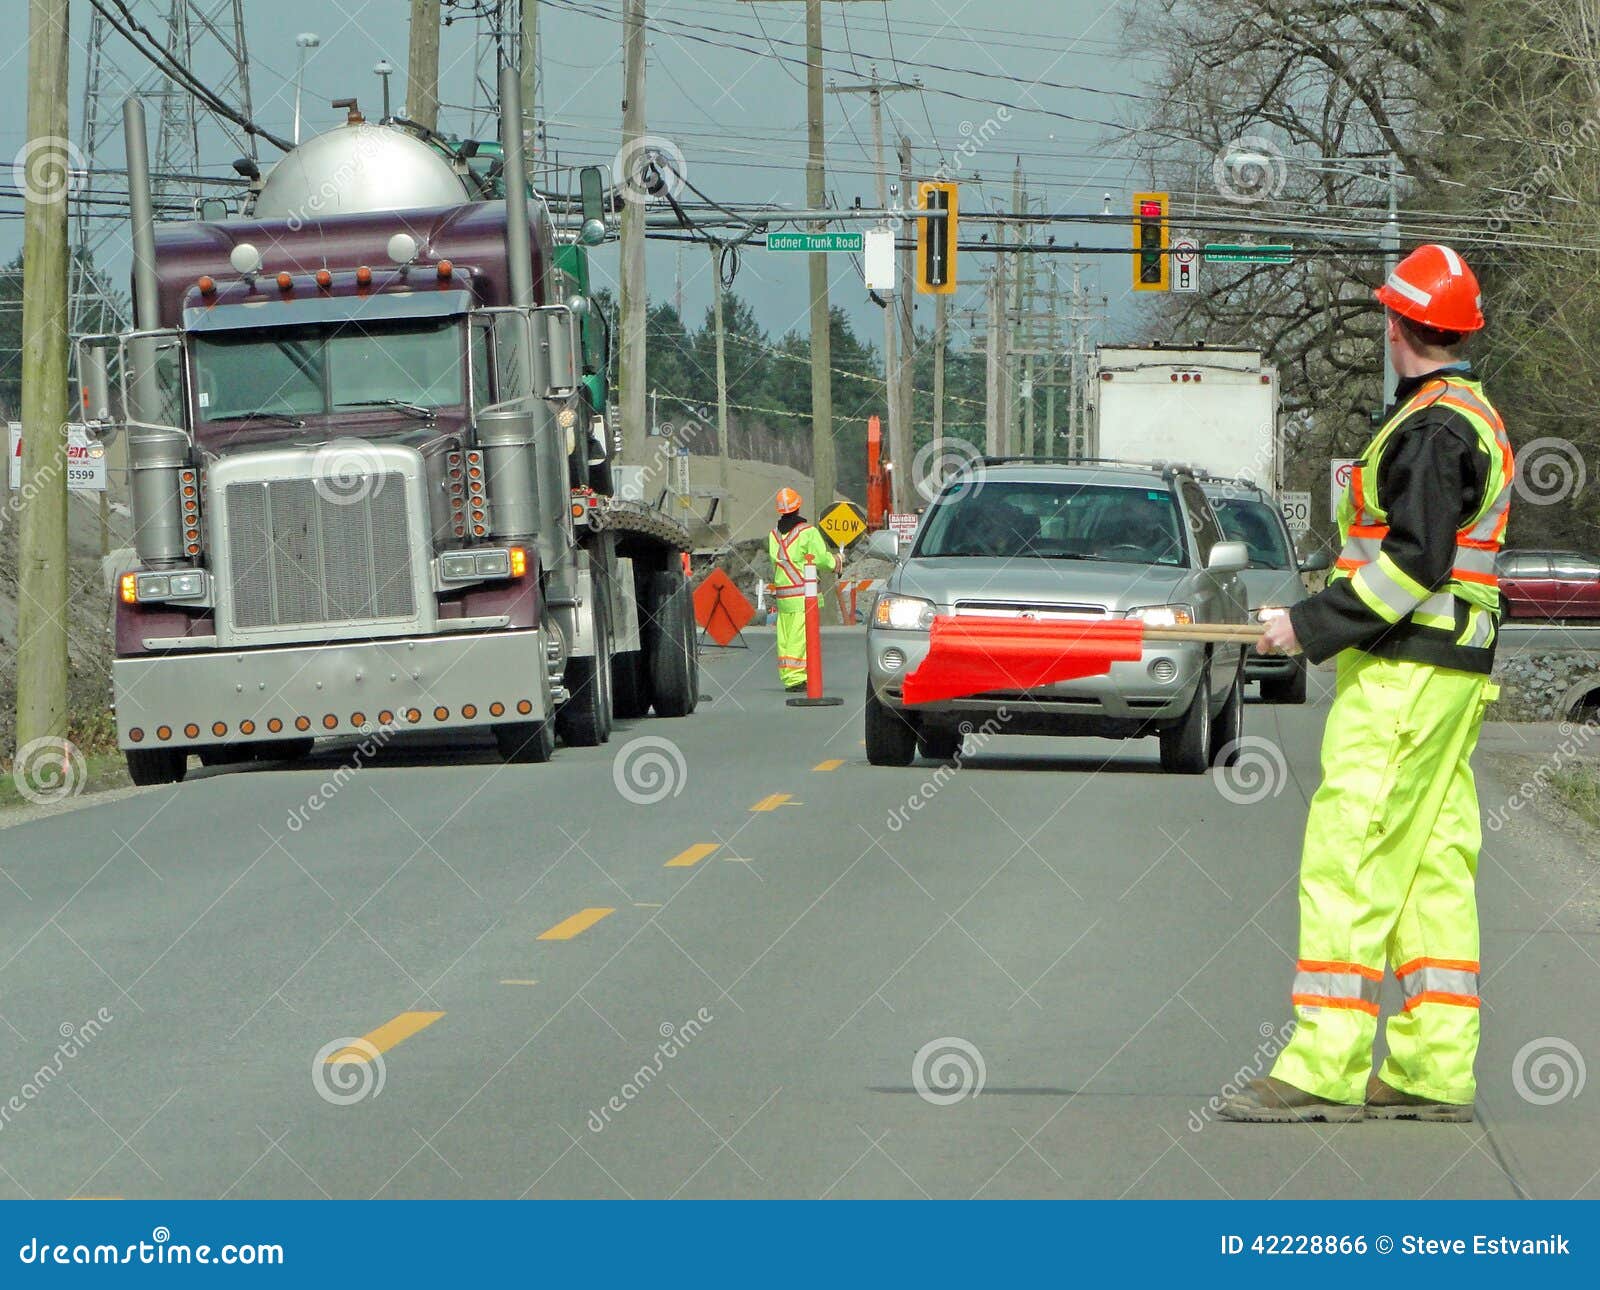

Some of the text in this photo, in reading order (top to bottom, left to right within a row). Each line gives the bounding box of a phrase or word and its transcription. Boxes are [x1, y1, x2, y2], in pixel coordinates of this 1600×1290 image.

[770, 236, 860, 249] Ladner Trunk Road
[1283, 503, 1307, 520] 50
[826, 518, 859, 533] SLOW
